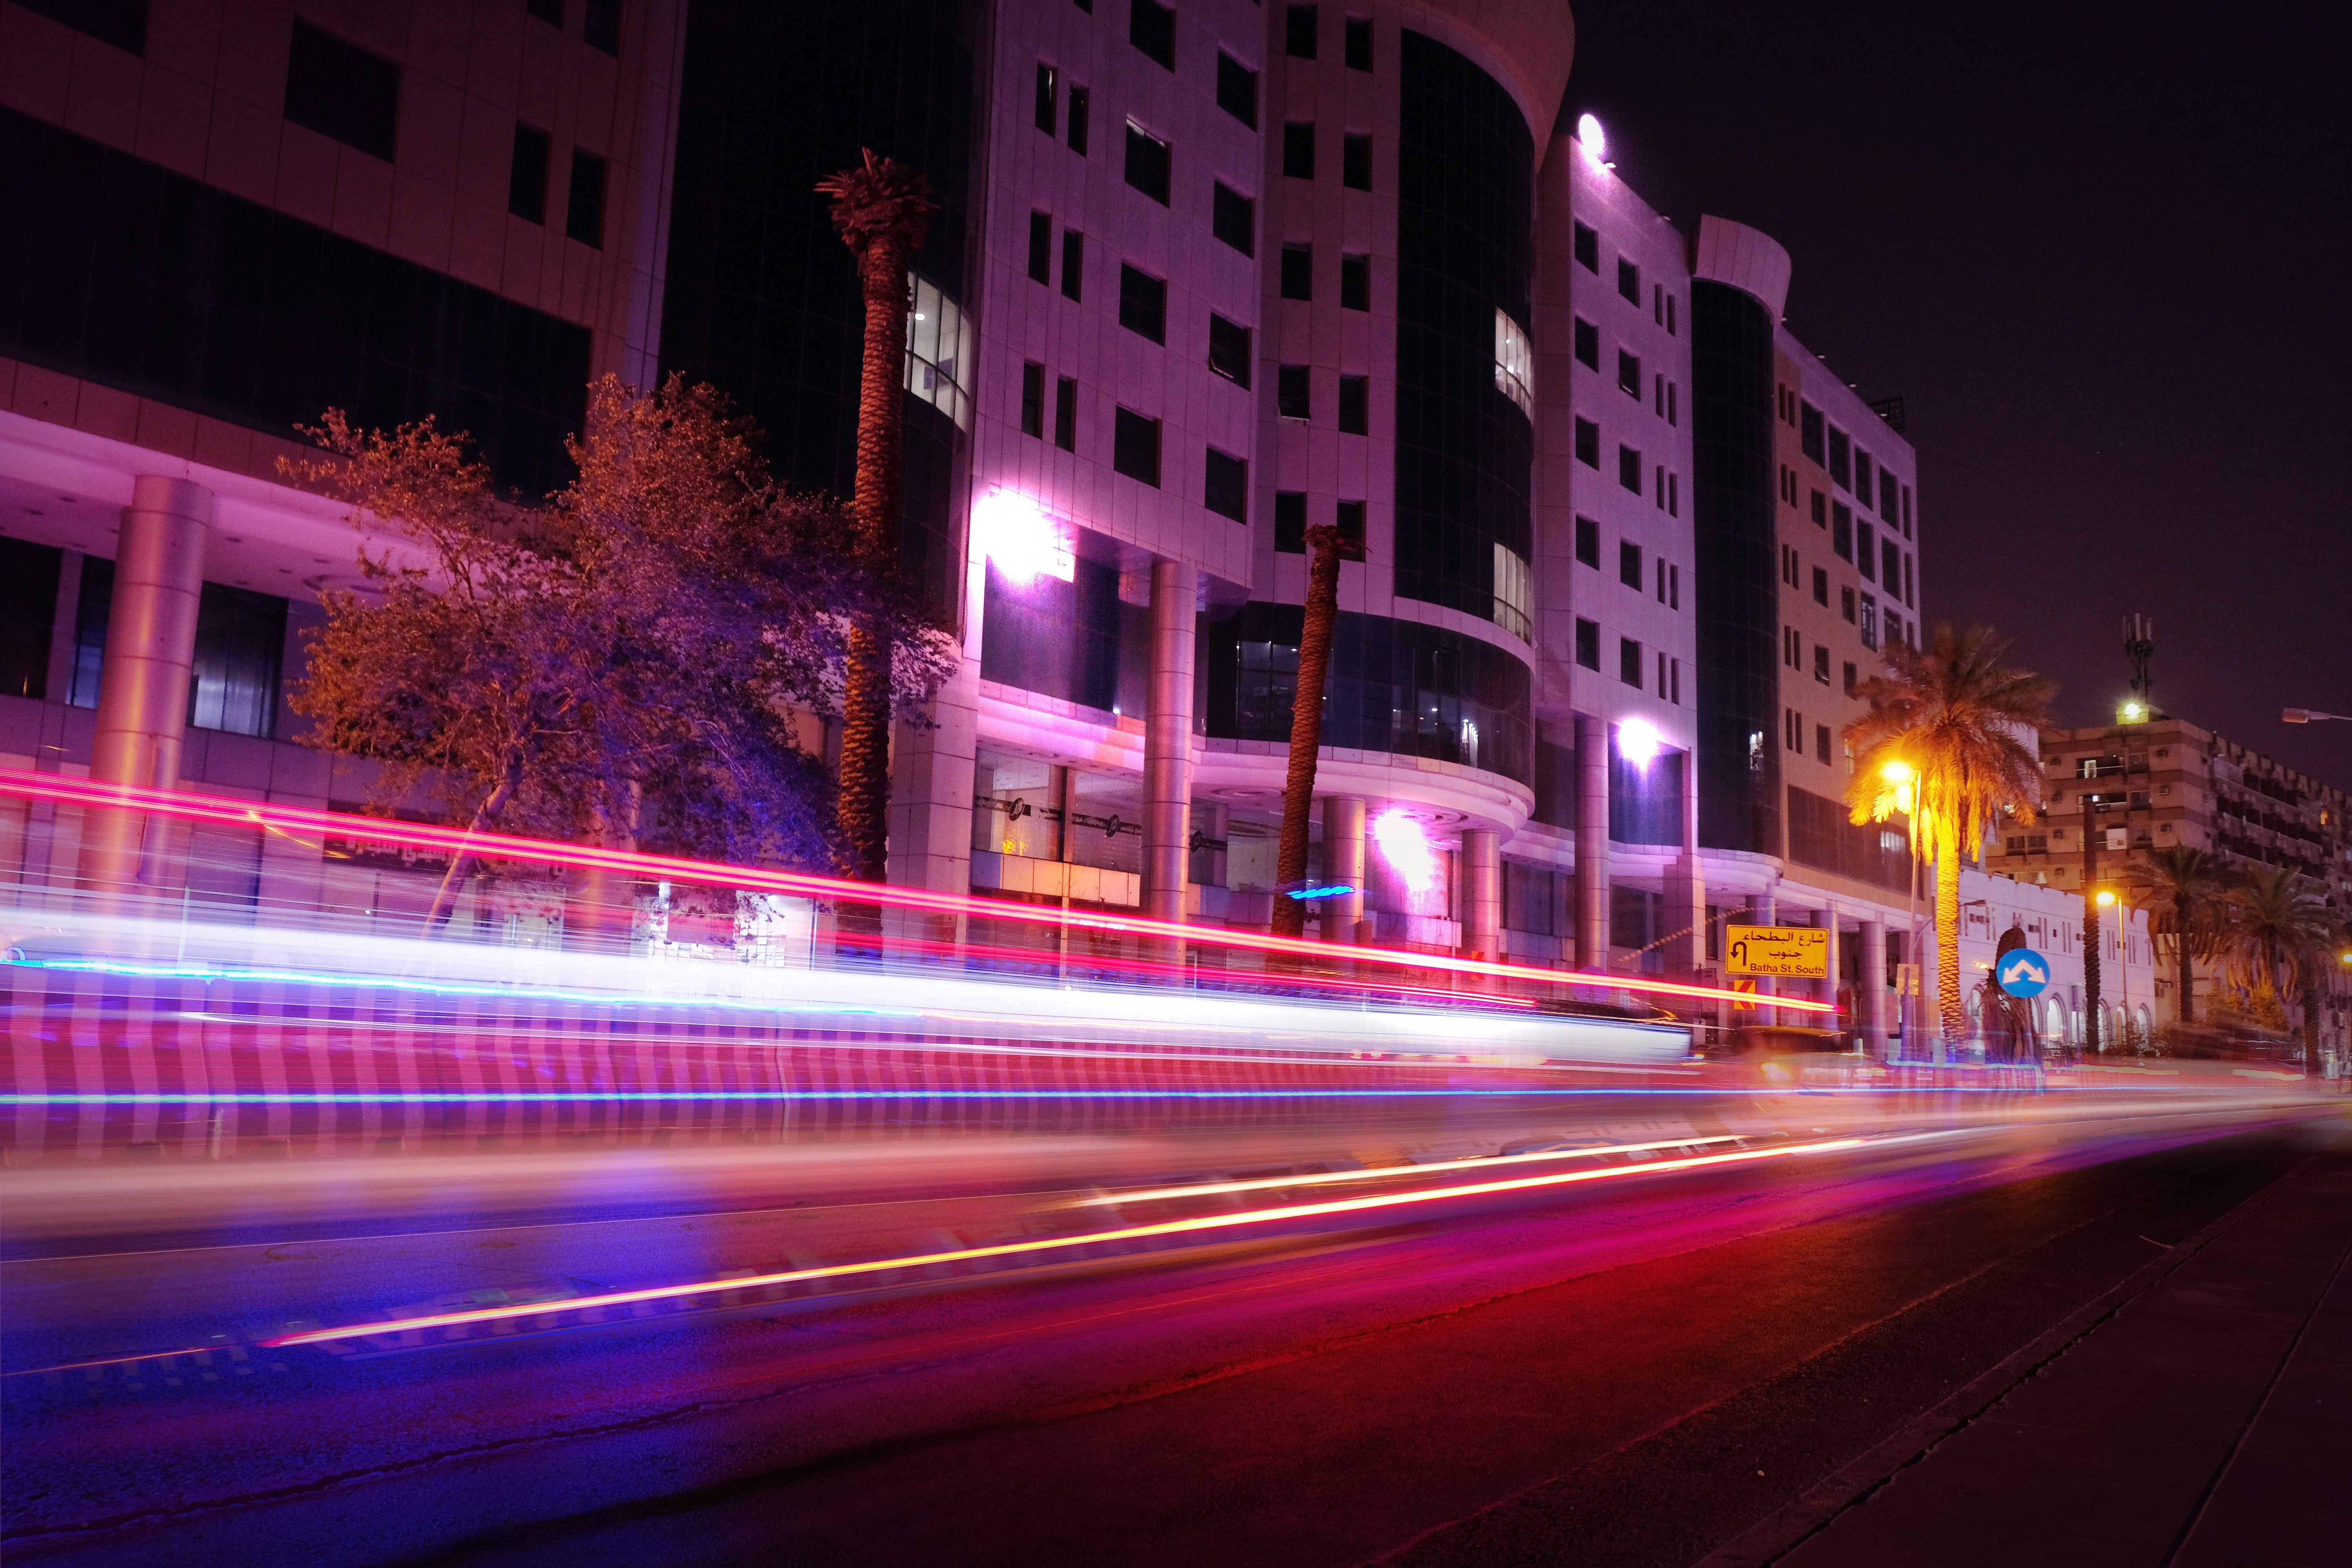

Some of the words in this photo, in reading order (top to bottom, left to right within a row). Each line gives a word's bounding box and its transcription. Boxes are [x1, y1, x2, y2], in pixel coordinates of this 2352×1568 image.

[1742, 930, 1794, 944] البطحاء
[1798, 933, 1825, 946] شارع
[1769, 950, 1802, 960] جنوب
[1750, 963, 1778, 973] Batha
[1780, 964, 1794, 973] St.
[1795, 965, 1824, 975] South
